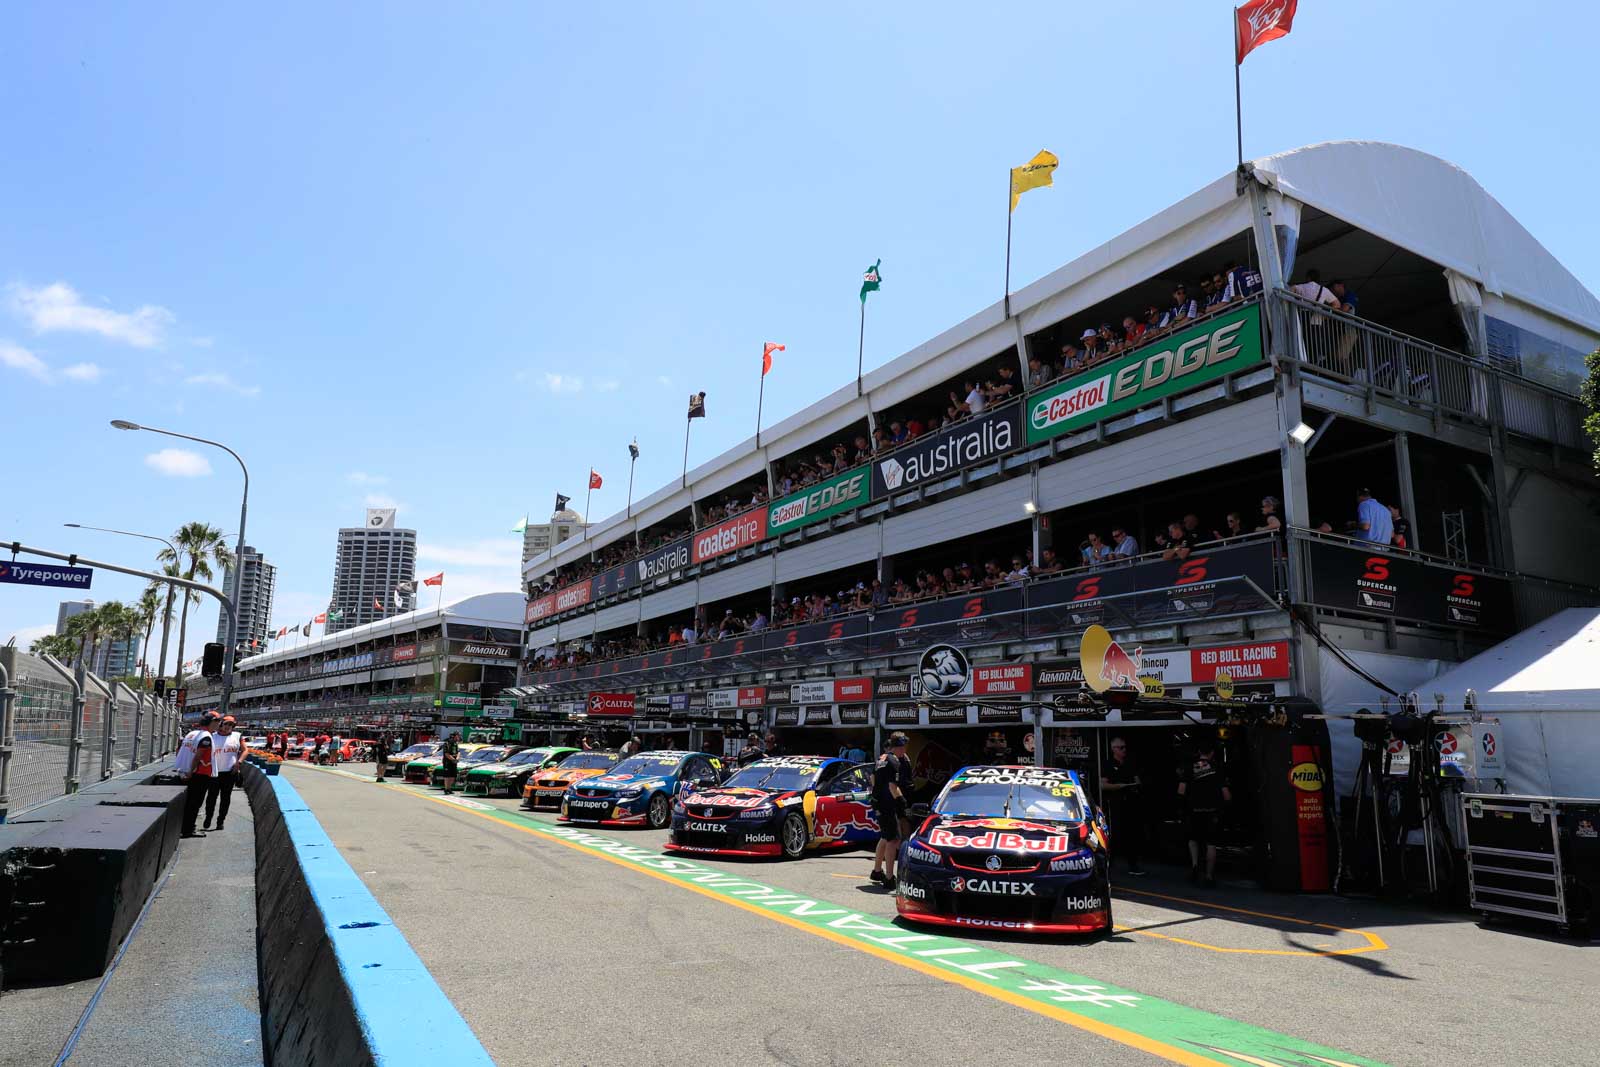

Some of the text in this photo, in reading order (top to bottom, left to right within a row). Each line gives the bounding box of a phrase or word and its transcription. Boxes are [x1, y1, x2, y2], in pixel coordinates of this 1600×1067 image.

[1049, 318, 1248, 422] Castrol EDGE
[905, 419, 1012, 483] australia
[777, 499, 805, 523] Castrol
[806, 473, 864, 516] EDGE
[698, 518, 758, 559] coateshire
[647, 545, 688, 578] australia
[11, 565, 89, 583] Tyrepower
[1356, 579, 1397, 592] SUPERCARS
[1446, 595, 1481, 607] SUPERCARS
[463, 644, 510, 657] ARMORALL
[1200, 646, 1277, 664] RED BULL RACING
[979, 667, 1024, 681] RED BULL RACING
[1038, 669, 1085, 684] ARMORALL
[1214, 663, 1262, 678] AUSTRALIA
[987, 681, 1015, 692] AUSTRALIA
[605, 700, 633, 708] CALTEX
[965, 768, 1067, 779] CALTEX
[1051, 787, 1072, 797] 88
[584, 800, 602, 809] super
[684, 794, 764, 807] Red Bull
[691, 822, 728, 833] CALTEX
[745, 833, 775, 843] Holden
[929, 829, 1069, 852] Red Bull
[966, 878, 1037, 896] CALTEX
[1067, 896, 1101, 911] Holden
